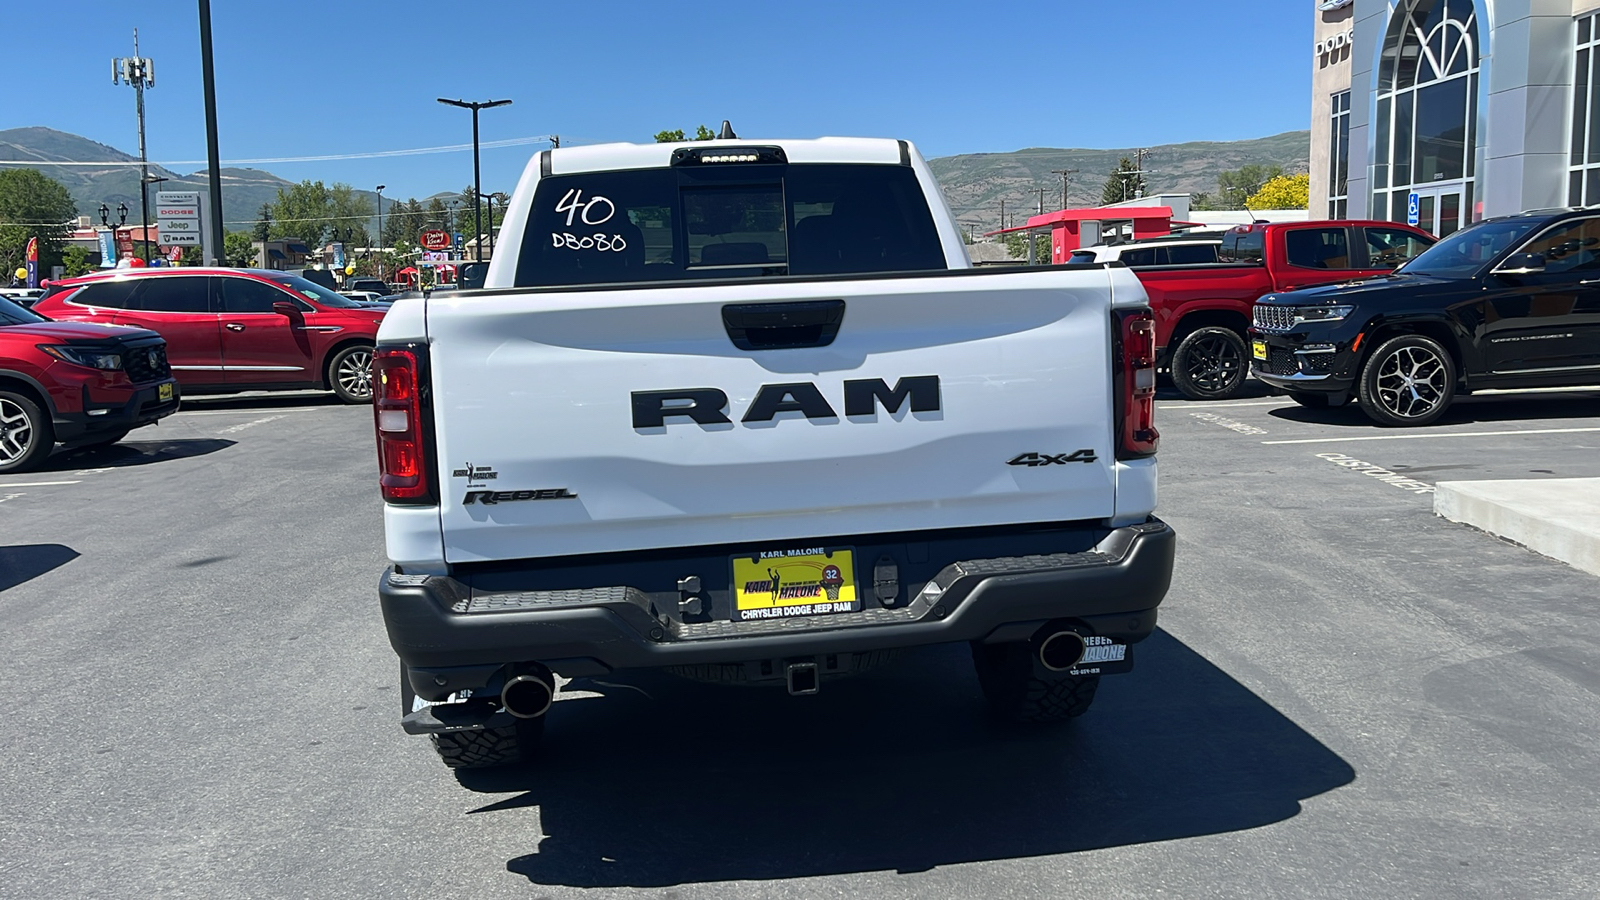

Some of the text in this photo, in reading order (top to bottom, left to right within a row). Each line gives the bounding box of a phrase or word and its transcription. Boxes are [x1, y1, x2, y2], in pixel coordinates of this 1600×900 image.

[555, 188, 615, 226] 40
[167, 221, 189, 230] Jeep
[99, 233, 109, 260] UNIDAD
[551, 232, 627, 252] DB080
[631, 375, 940, 428] RAM
[1315, 452, 1437, 494] CUSTOMER
[462, 488, 578, 505] REBEL
[760, 547, 825, 559] KARL MALONE
[825, 569, 838, 579] 32
[743, 580, 821, 600] KARL MALONE
[741, 601, 852, 620] CHRYSLER DODGE JEEP RAM
